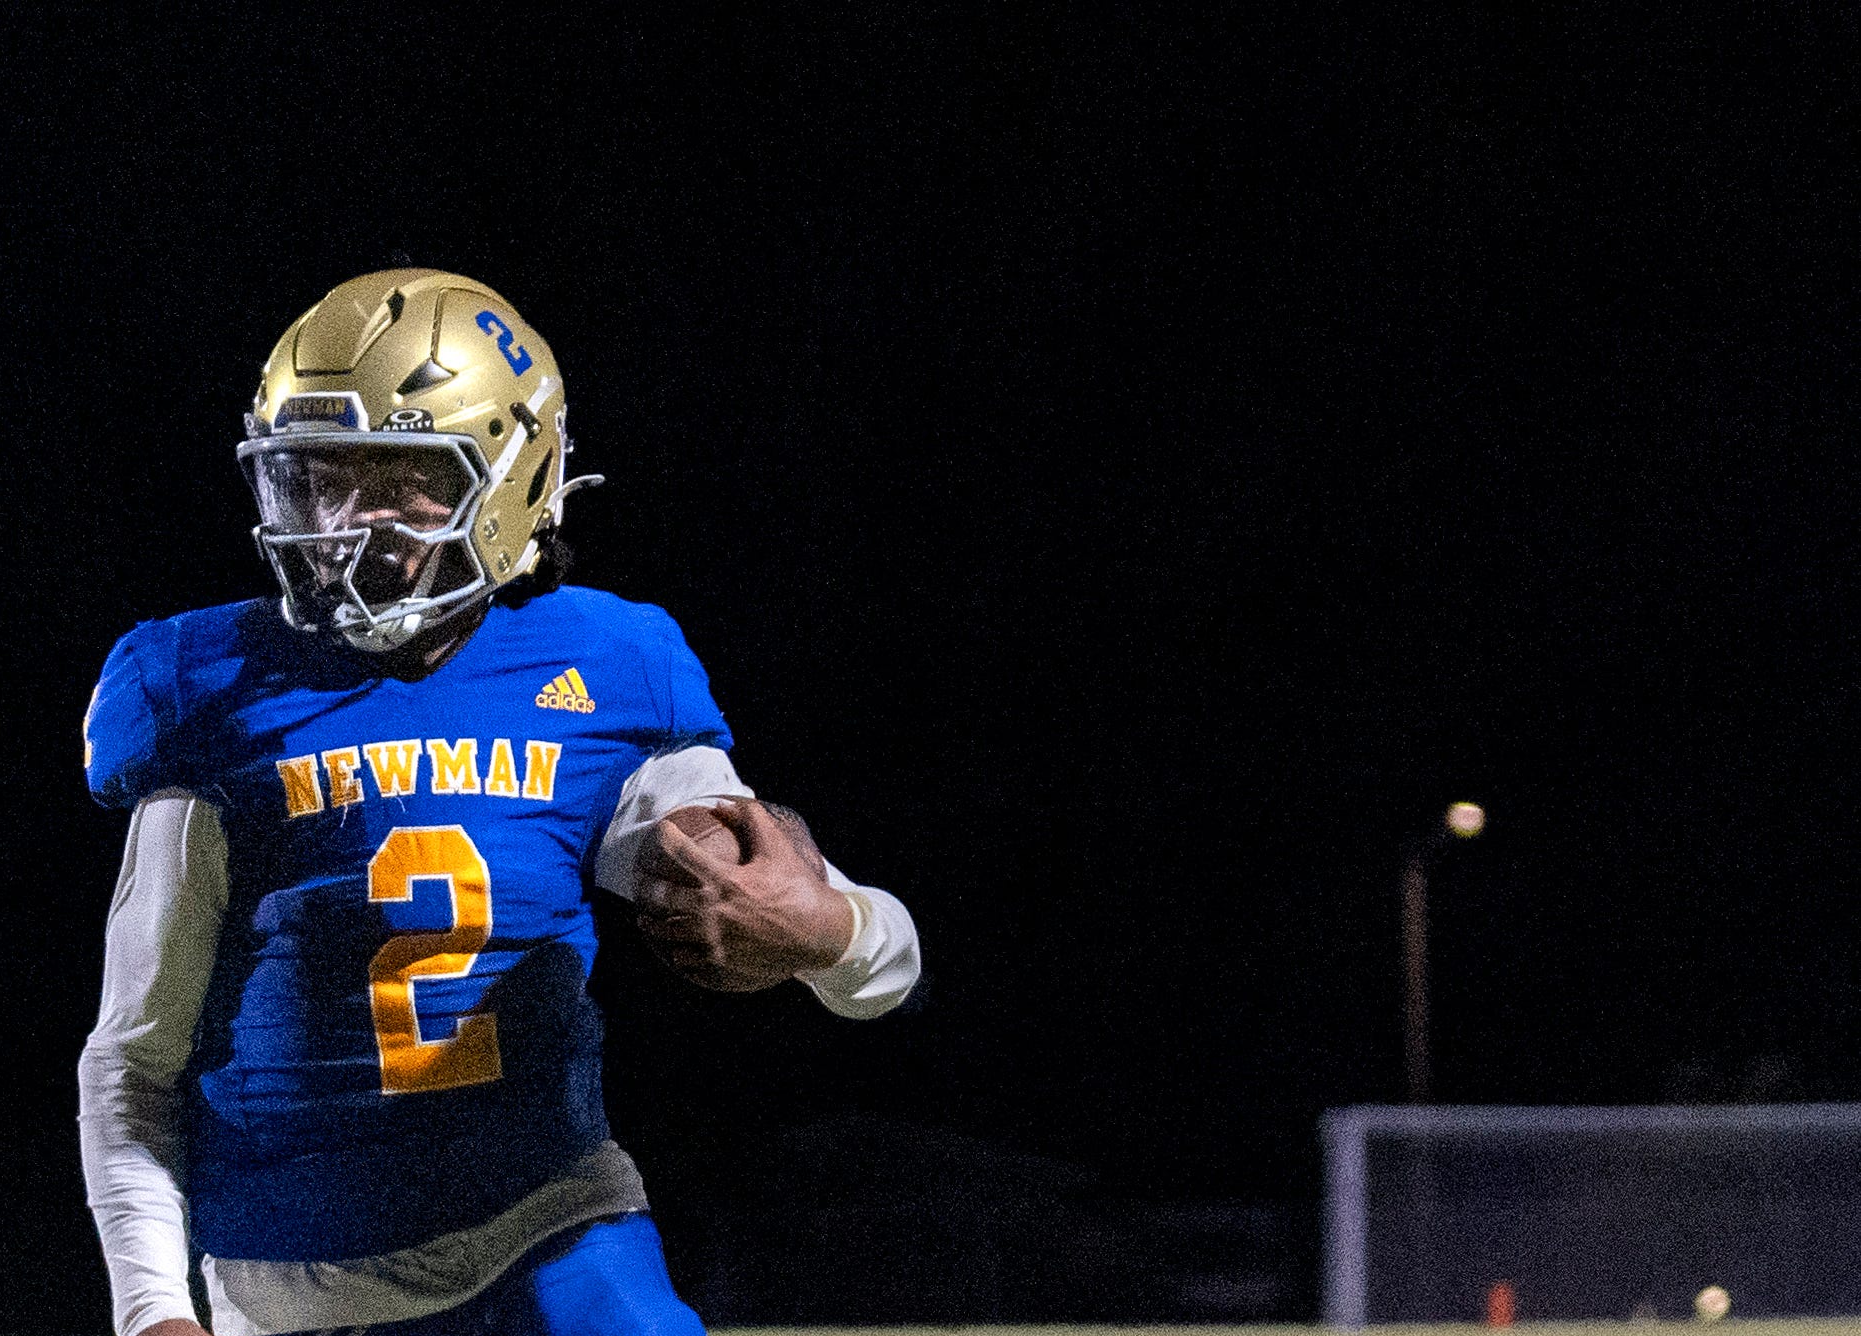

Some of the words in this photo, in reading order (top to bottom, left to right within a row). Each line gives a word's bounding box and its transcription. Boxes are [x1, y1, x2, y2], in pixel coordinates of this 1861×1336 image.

[475, 310, 533, 377] 2
[535, 693, 596, 714] adidas
[276, 738, 563, 818] NEWMAN
[367, 824, 503, 1095] 2
